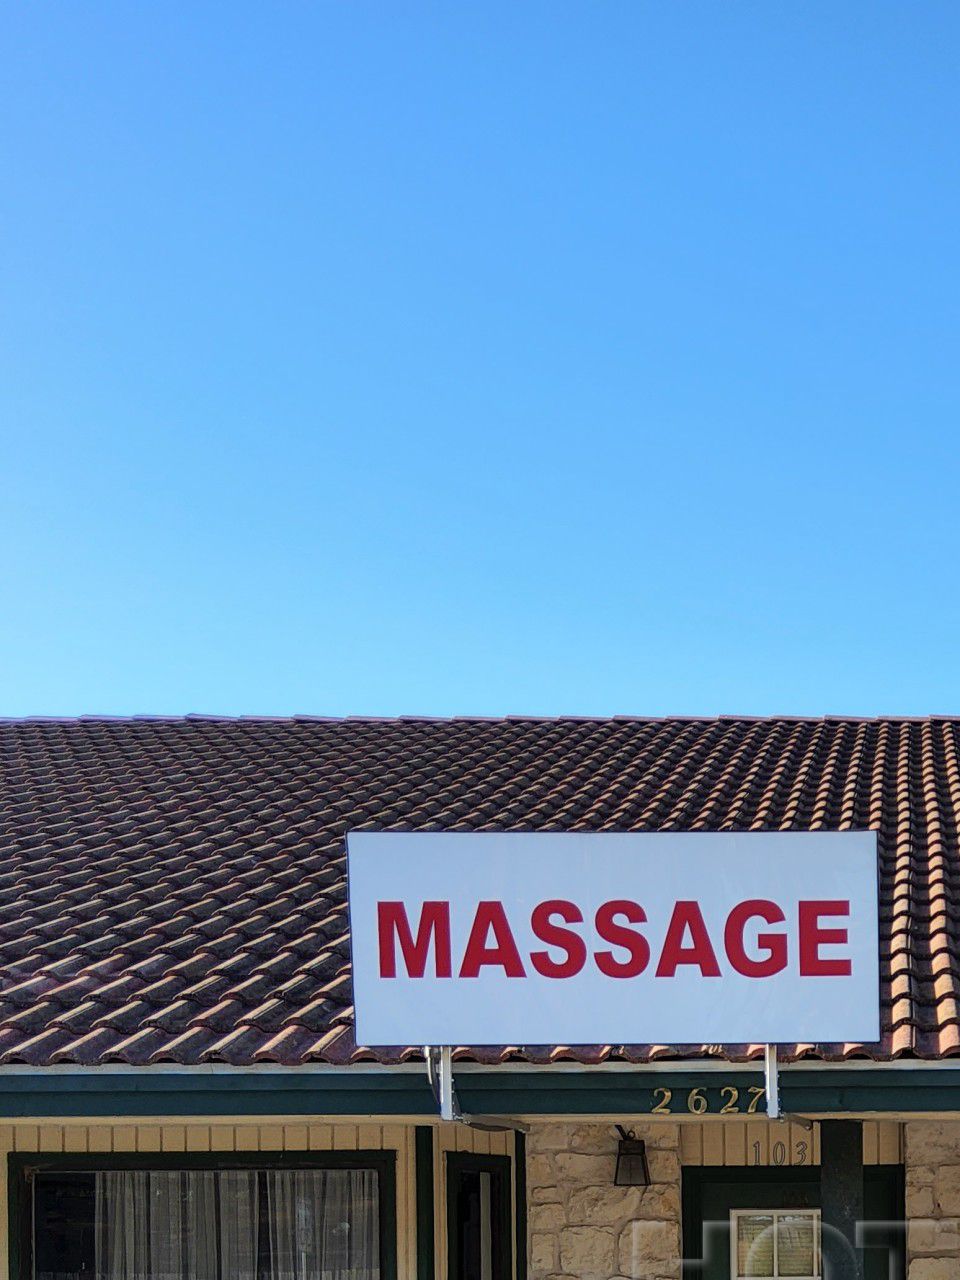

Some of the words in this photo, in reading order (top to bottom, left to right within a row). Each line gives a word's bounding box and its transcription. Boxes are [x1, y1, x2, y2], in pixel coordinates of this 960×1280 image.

[376, 898, 852, 979] MASSAGE
[651, 1086, 766, 1114] 2627
[752, 1140, 809, 1166] 103
